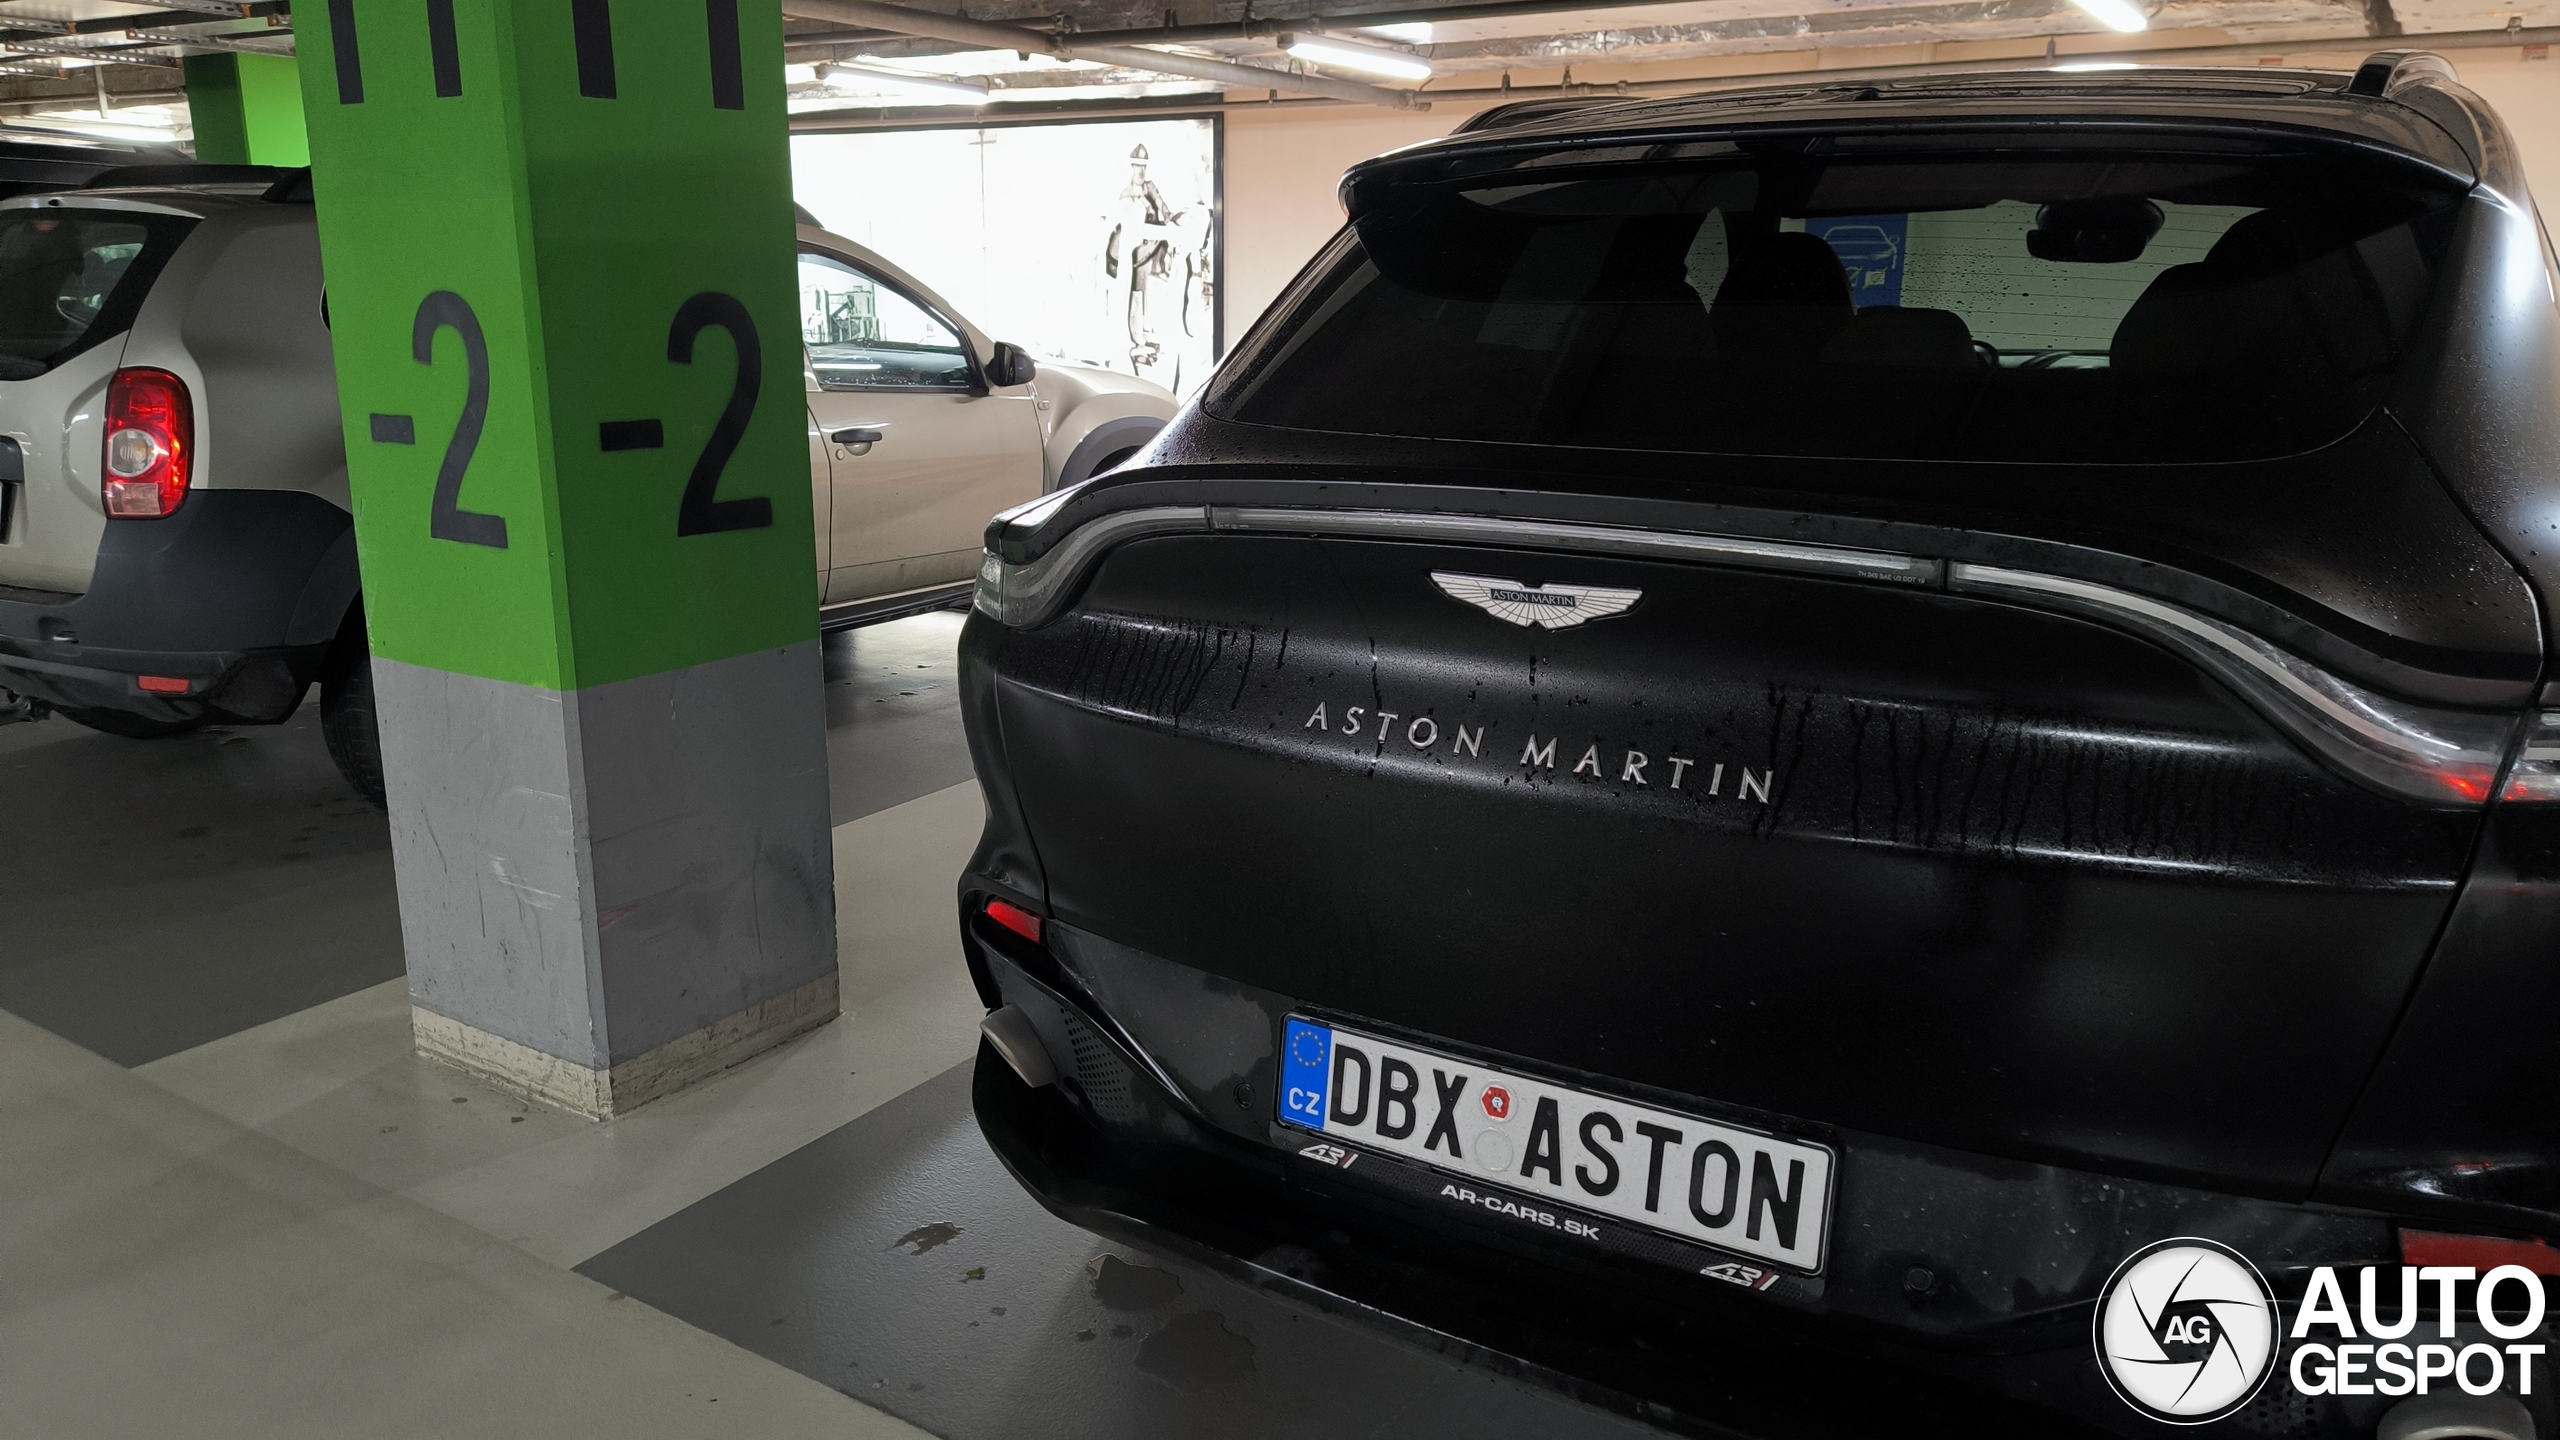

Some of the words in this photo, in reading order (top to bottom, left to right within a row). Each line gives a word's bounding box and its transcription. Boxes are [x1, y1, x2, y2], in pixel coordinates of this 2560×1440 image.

[370, 290, 508, 549] -2
[600, 291, 773, 537] -2
[1492, 590, 1529, 602] ASTON
[1531, 595, 1575, 606] MARTIN
[1304, 701, 1485, 759] ASTON
[1519, 733, 1774, 805] MARTIN
[1288, 1087, 1321, 1116] CZ
[1329, 1042, 1469, 1159] DBX
[1520, 1095, 1806, 1251] ASTON
[1440, 1184, 1600, 1241] AR-CARS.SK
